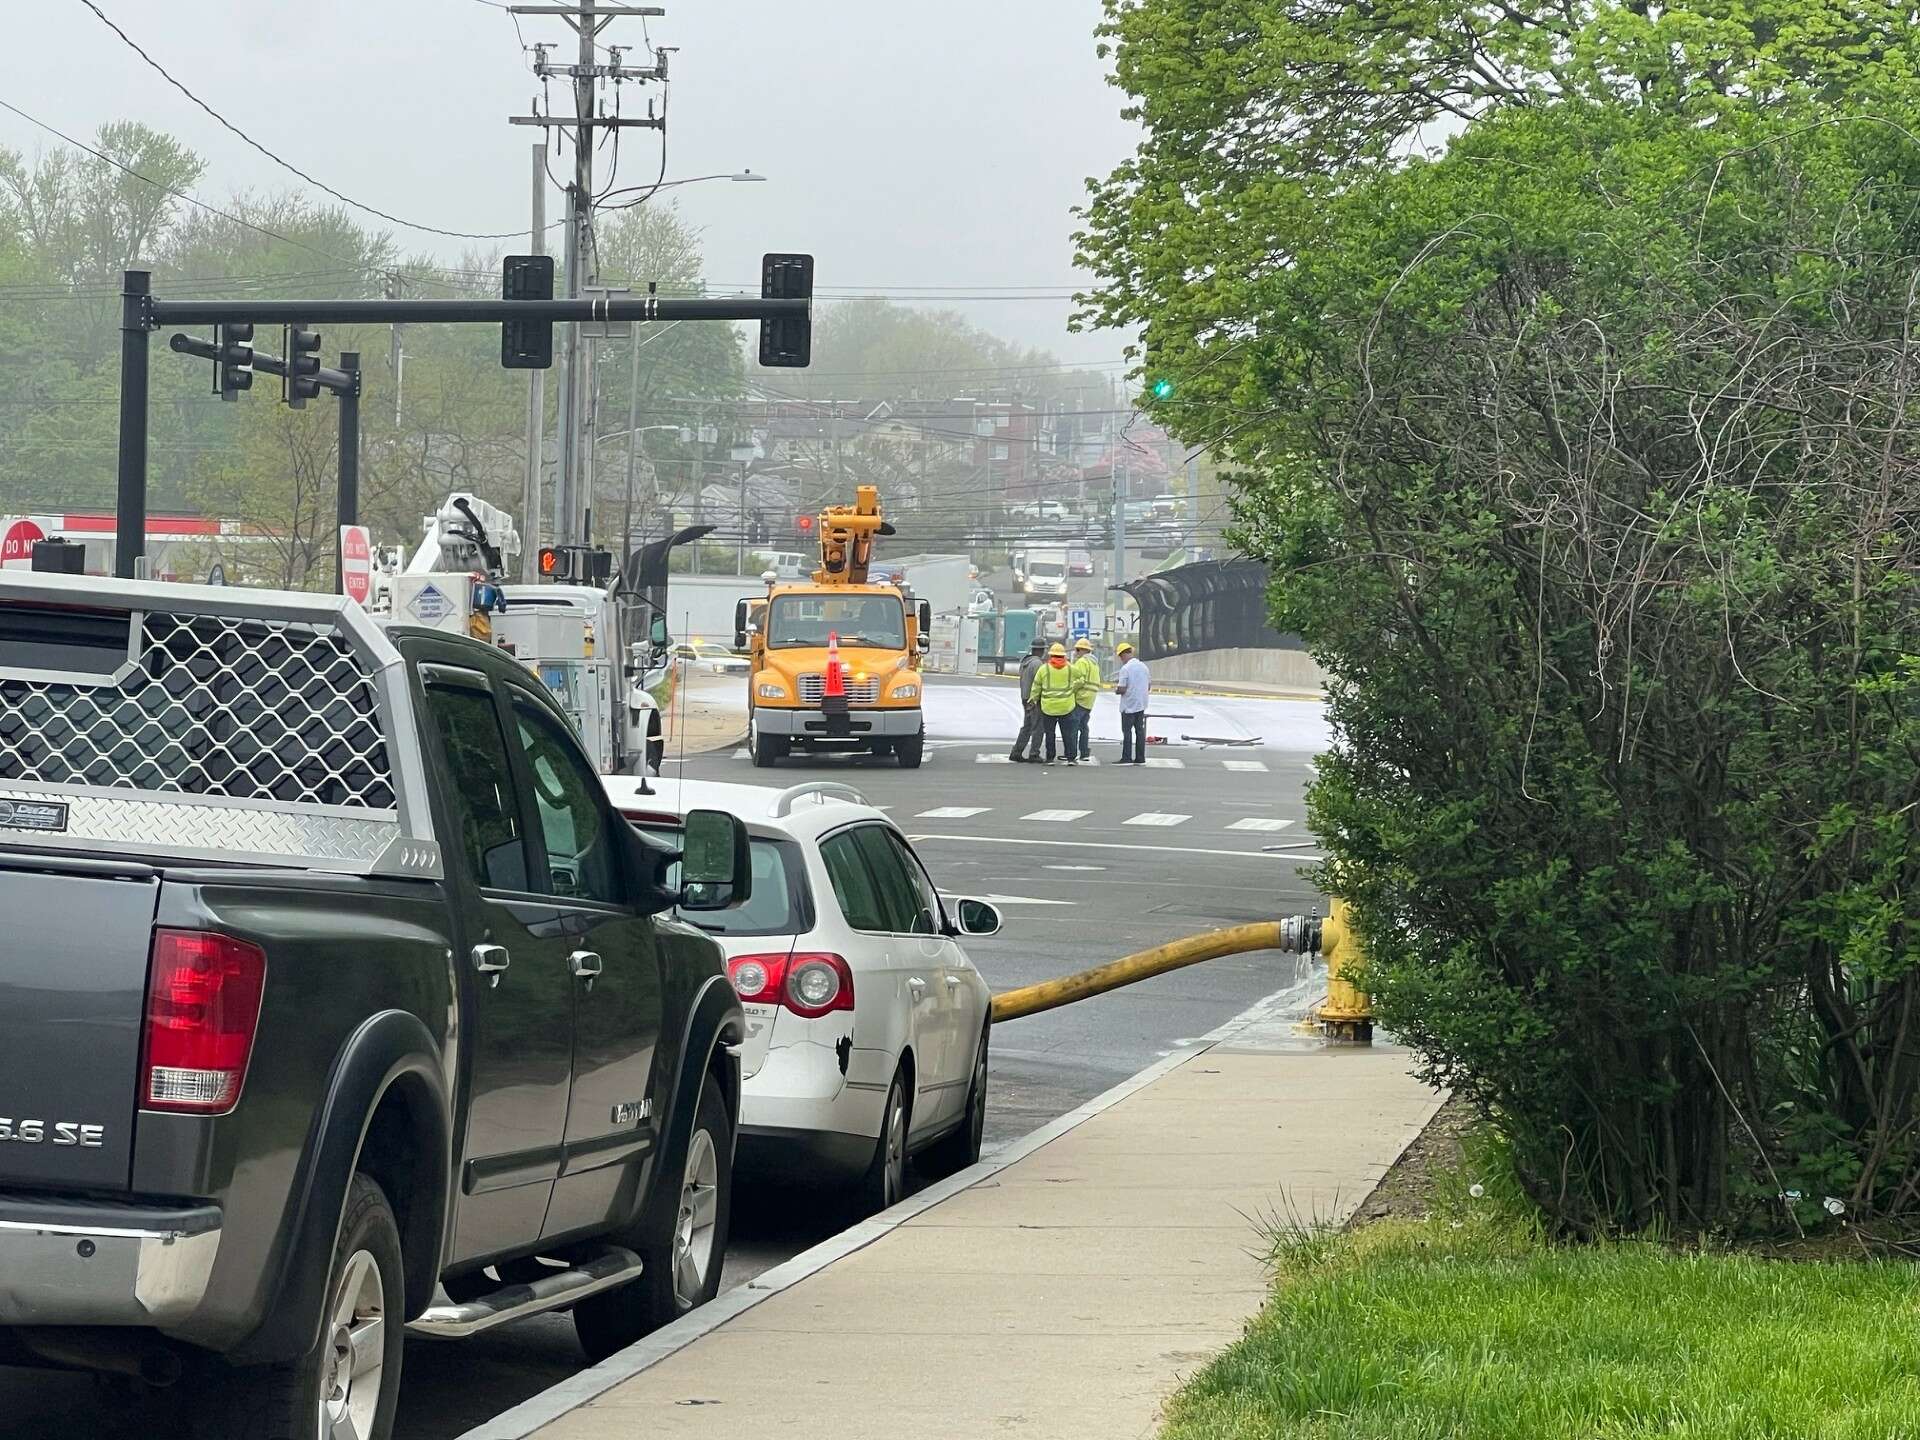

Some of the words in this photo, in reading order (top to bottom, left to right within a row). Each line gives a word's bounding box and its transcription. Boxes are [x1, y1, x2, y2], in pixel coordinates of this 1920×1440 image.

[6, 539, 18, 554] DO
[355, 543, 367, 555] NOT
[349, 577, 365, 589] ENTER
[1074, 611, 1088, 628] H
[52, 1122, 105, 1148] SE
